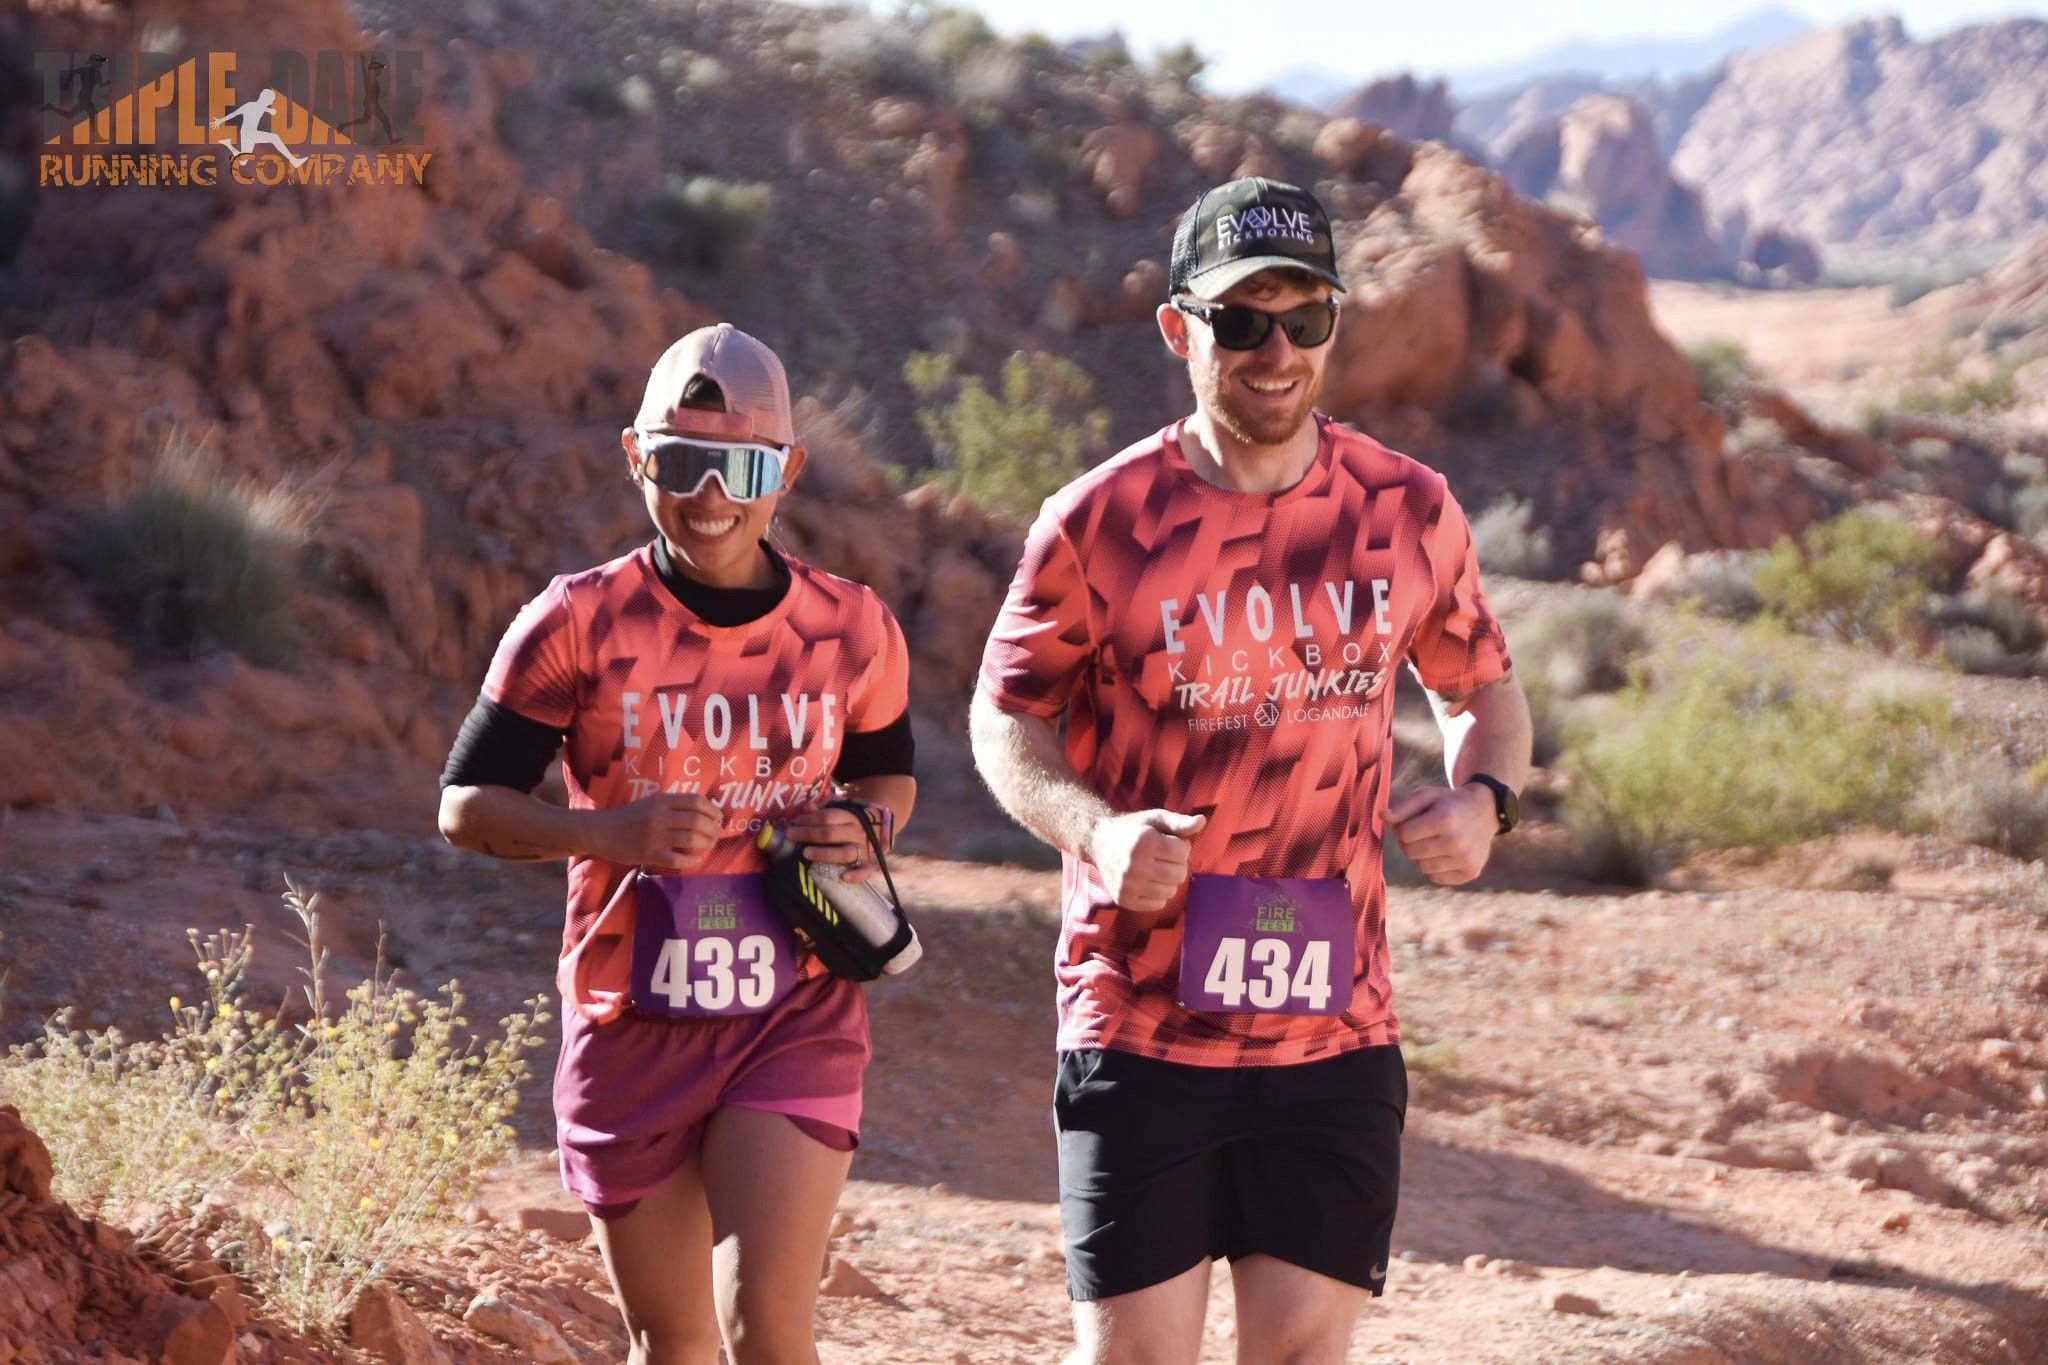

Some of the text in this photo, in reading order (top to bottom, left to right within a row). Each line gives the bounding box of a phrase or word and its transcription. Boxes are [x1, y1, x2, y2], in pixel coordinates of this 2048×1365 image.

[1216, 206, 1313, 239] EVOLVE
[1217, 228, 1314, 250] KICKBOXING
[1160, 579, 1392, 655] EVOLVE
[1168, 642, 1392, 682] KICKBOX
[1175, 667, 1387, 710] TRAIL JUNKIES
[622, 692, 836, 750] EVOLVE
[1188, 703, 1371, 732] FIREFEST LOGANDALE
[624, 756, 832, 778] KICKBOX
[697, 904, 736, 917] FIRE
[700, 917, 735, 929] FEST
[1257, 907, 1297, 920] FIRE
[1258, 920, 1292, 931] FEST
[650, 934, 776, 1011] 433
[1204, 937, 1332, 1009] 434
